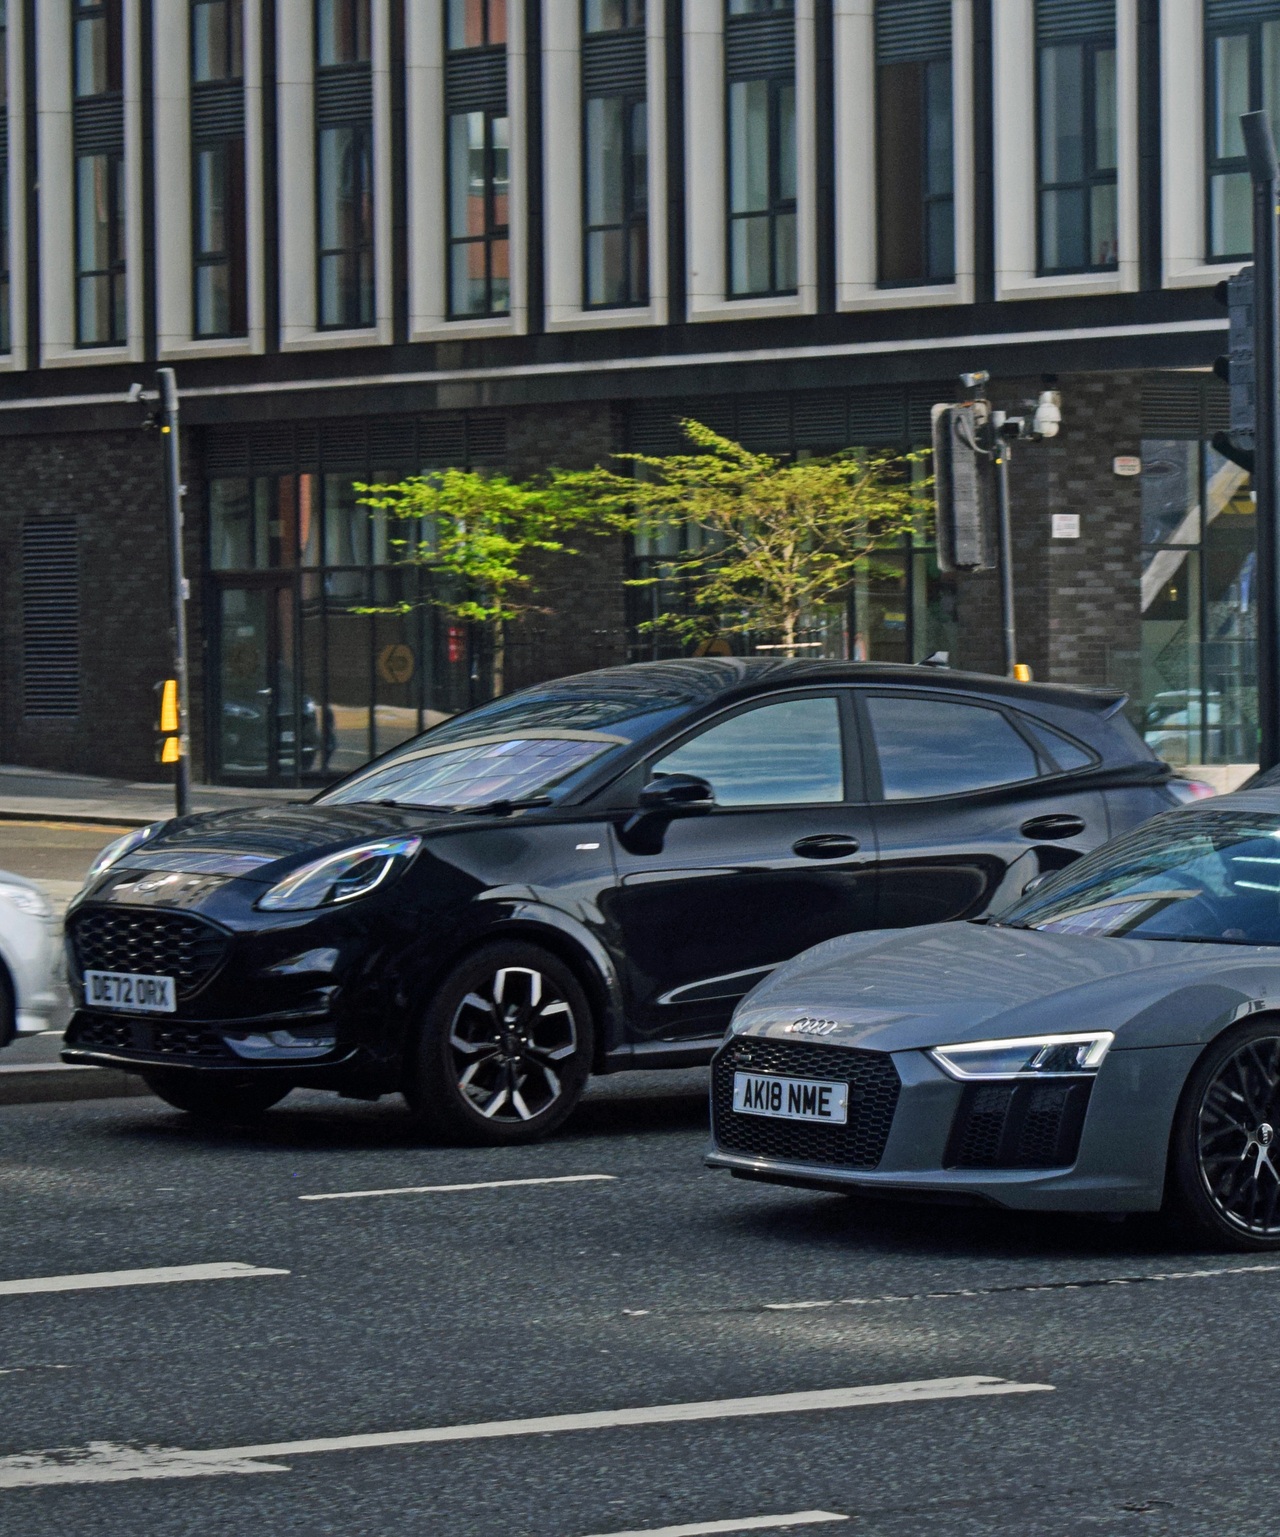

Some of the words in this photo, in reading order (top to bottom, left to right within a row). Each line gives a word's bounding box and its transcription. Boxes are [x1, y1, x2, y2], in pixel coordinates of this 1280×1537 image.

[92, 974, 133, 1003] DE72
[743, 1078, 782, 1112] AK18
[787, 1083, 833, 1117] NME
